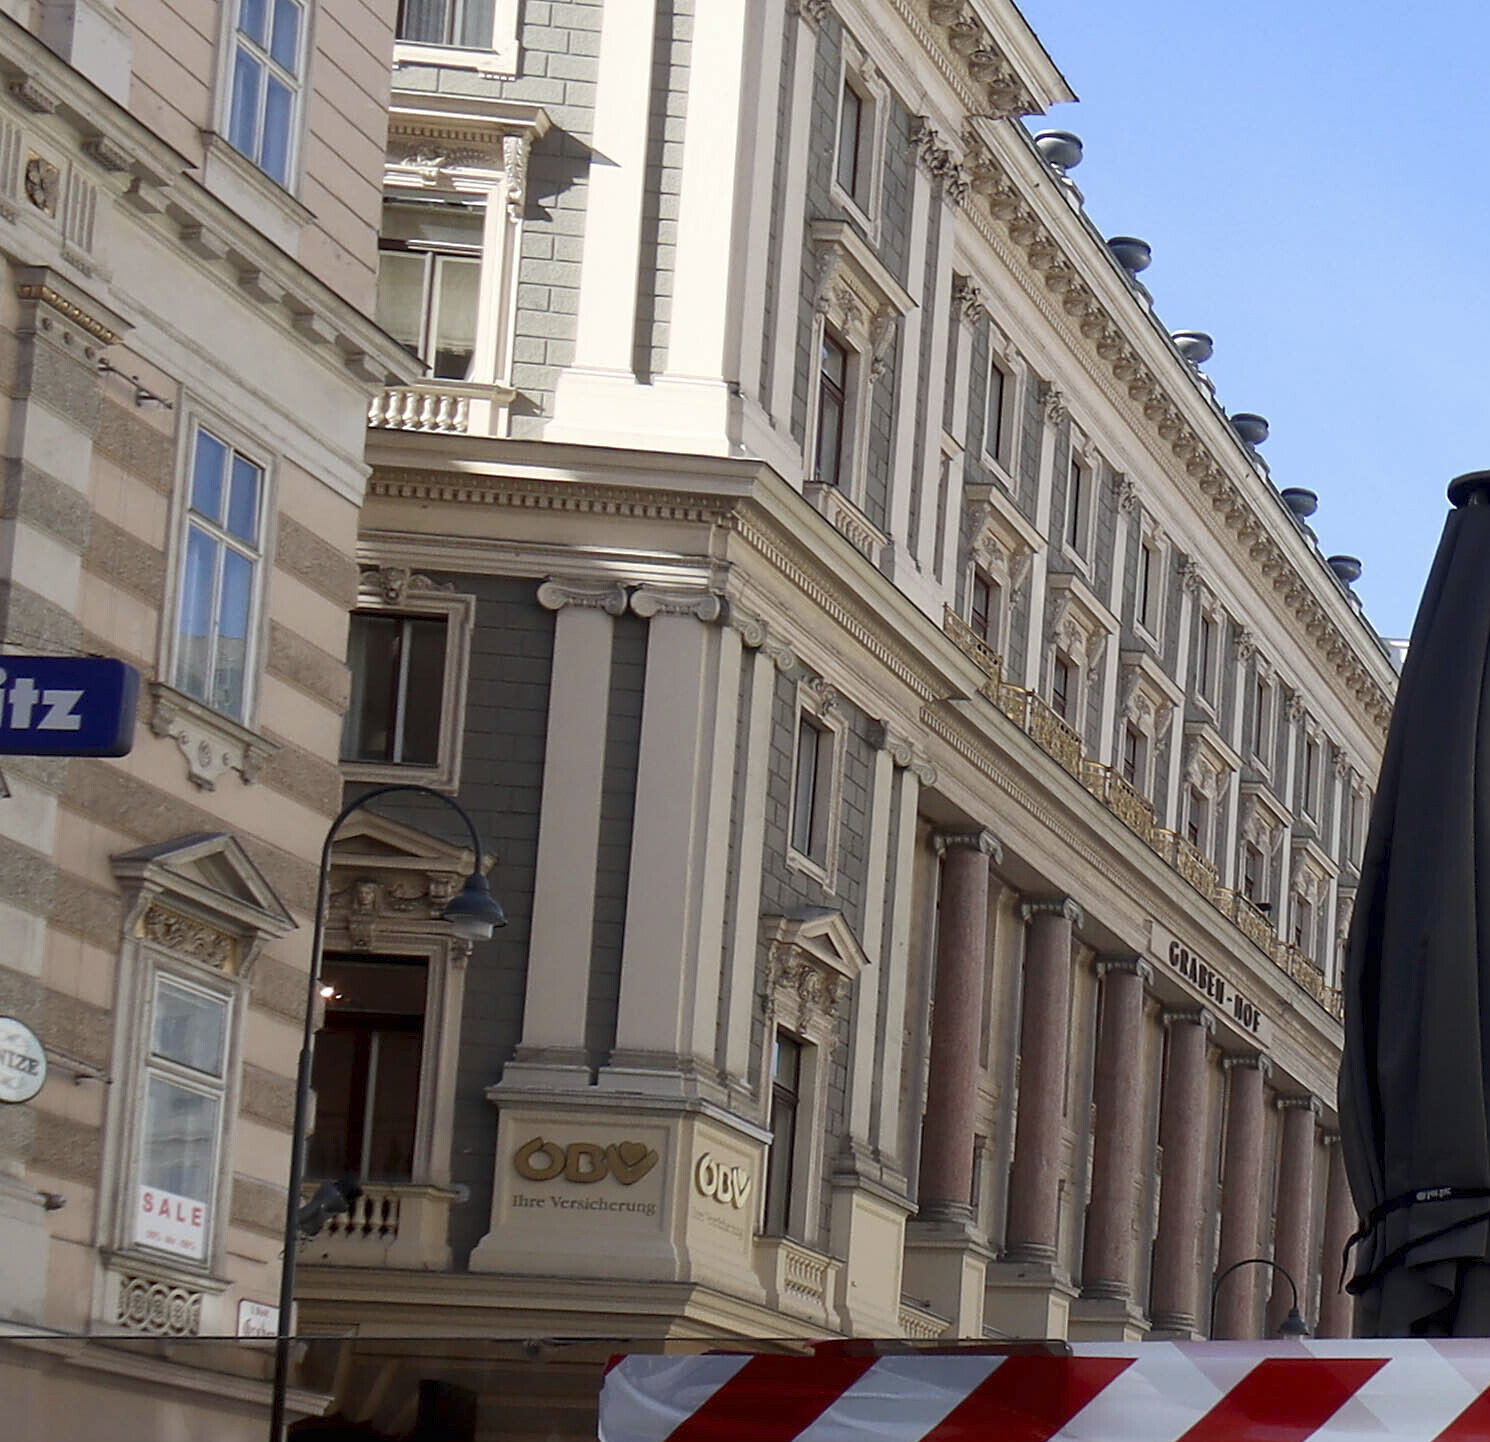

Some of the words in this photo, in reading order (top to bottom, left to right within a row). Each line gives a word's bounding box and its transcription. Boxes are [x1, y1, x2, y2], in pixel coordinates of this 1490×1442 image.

[143, 1192, 203, 1227] SALE
[512, 1195, 545, 1208] Ihre
[551, 1196, 657, 1217] Versicherung
